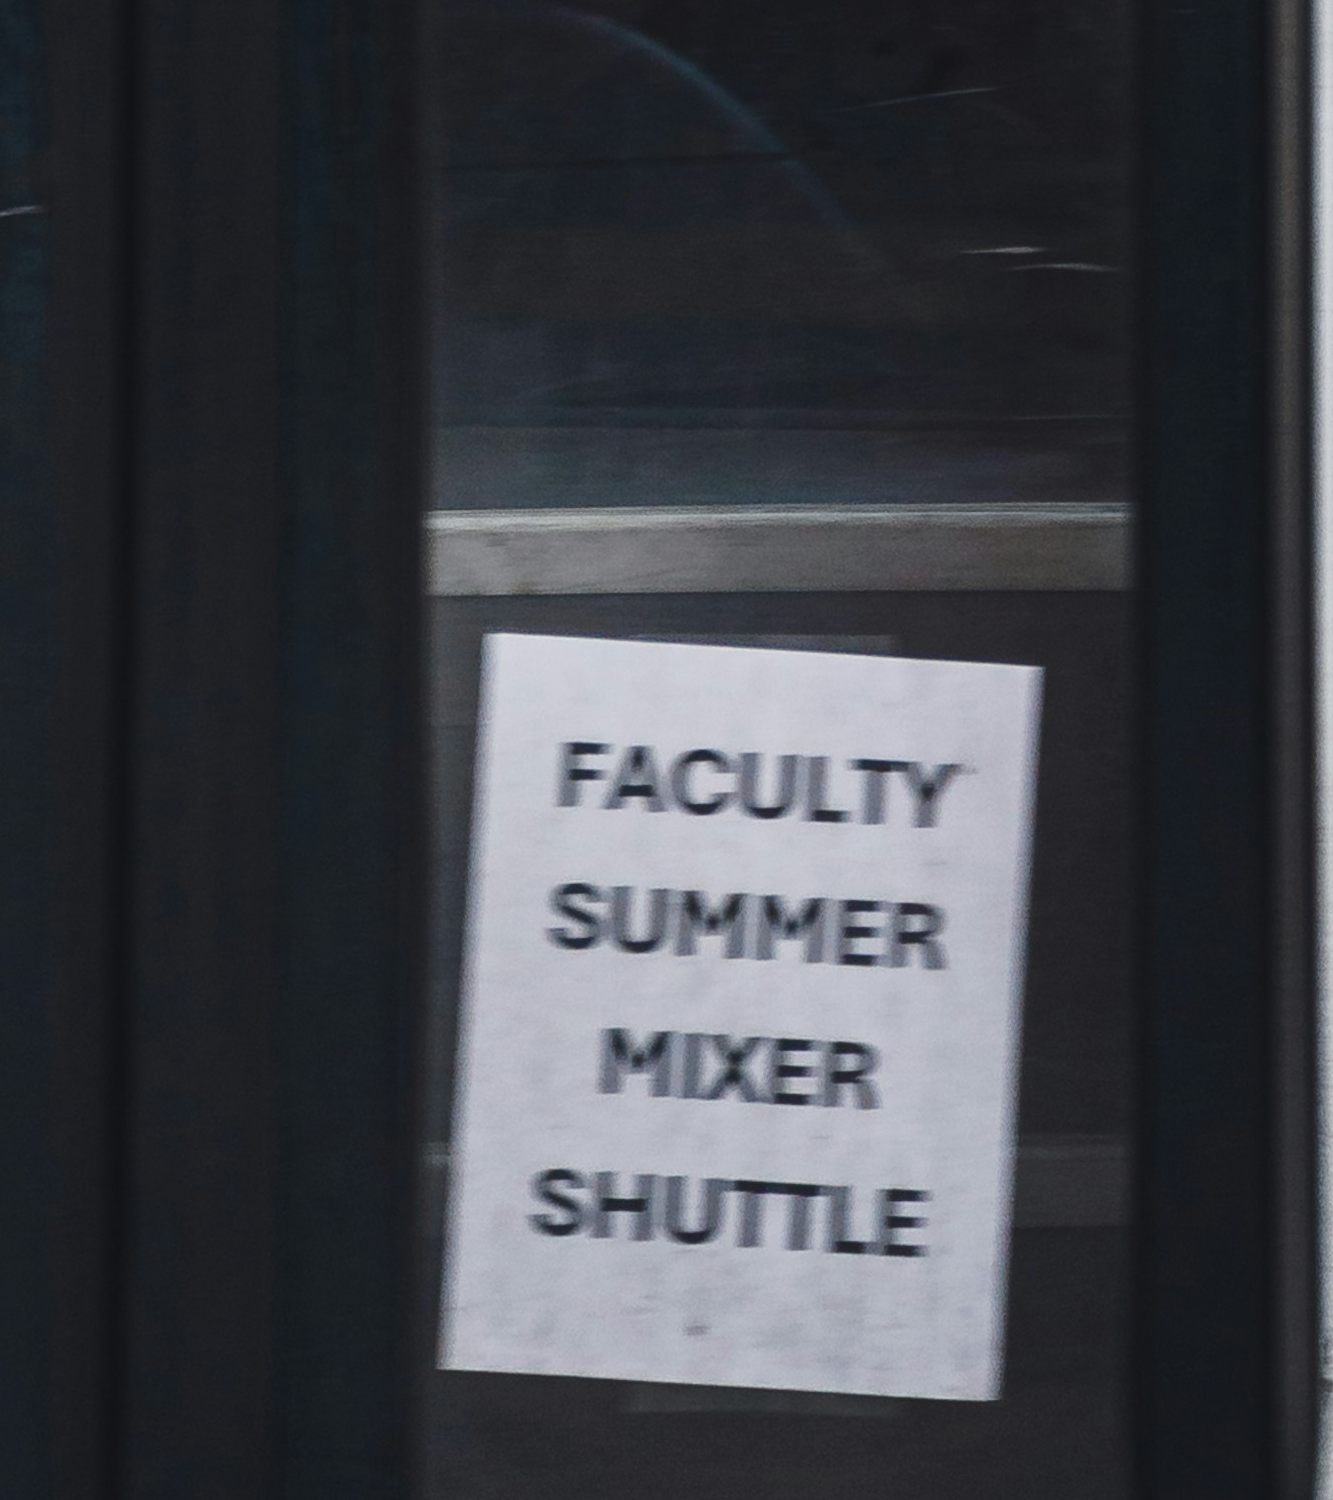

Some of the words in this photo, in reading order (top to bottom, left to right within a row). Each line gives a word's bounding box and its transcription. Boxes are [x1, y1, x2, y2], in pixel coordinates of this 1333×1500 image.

[552, 739, 960, 830] FACULTY
[543, 880, 952, 973] SUMMER
[594, 1025, 883, 1112] MIXER
[524, 1166, 934, 1260] SHUTTLE
